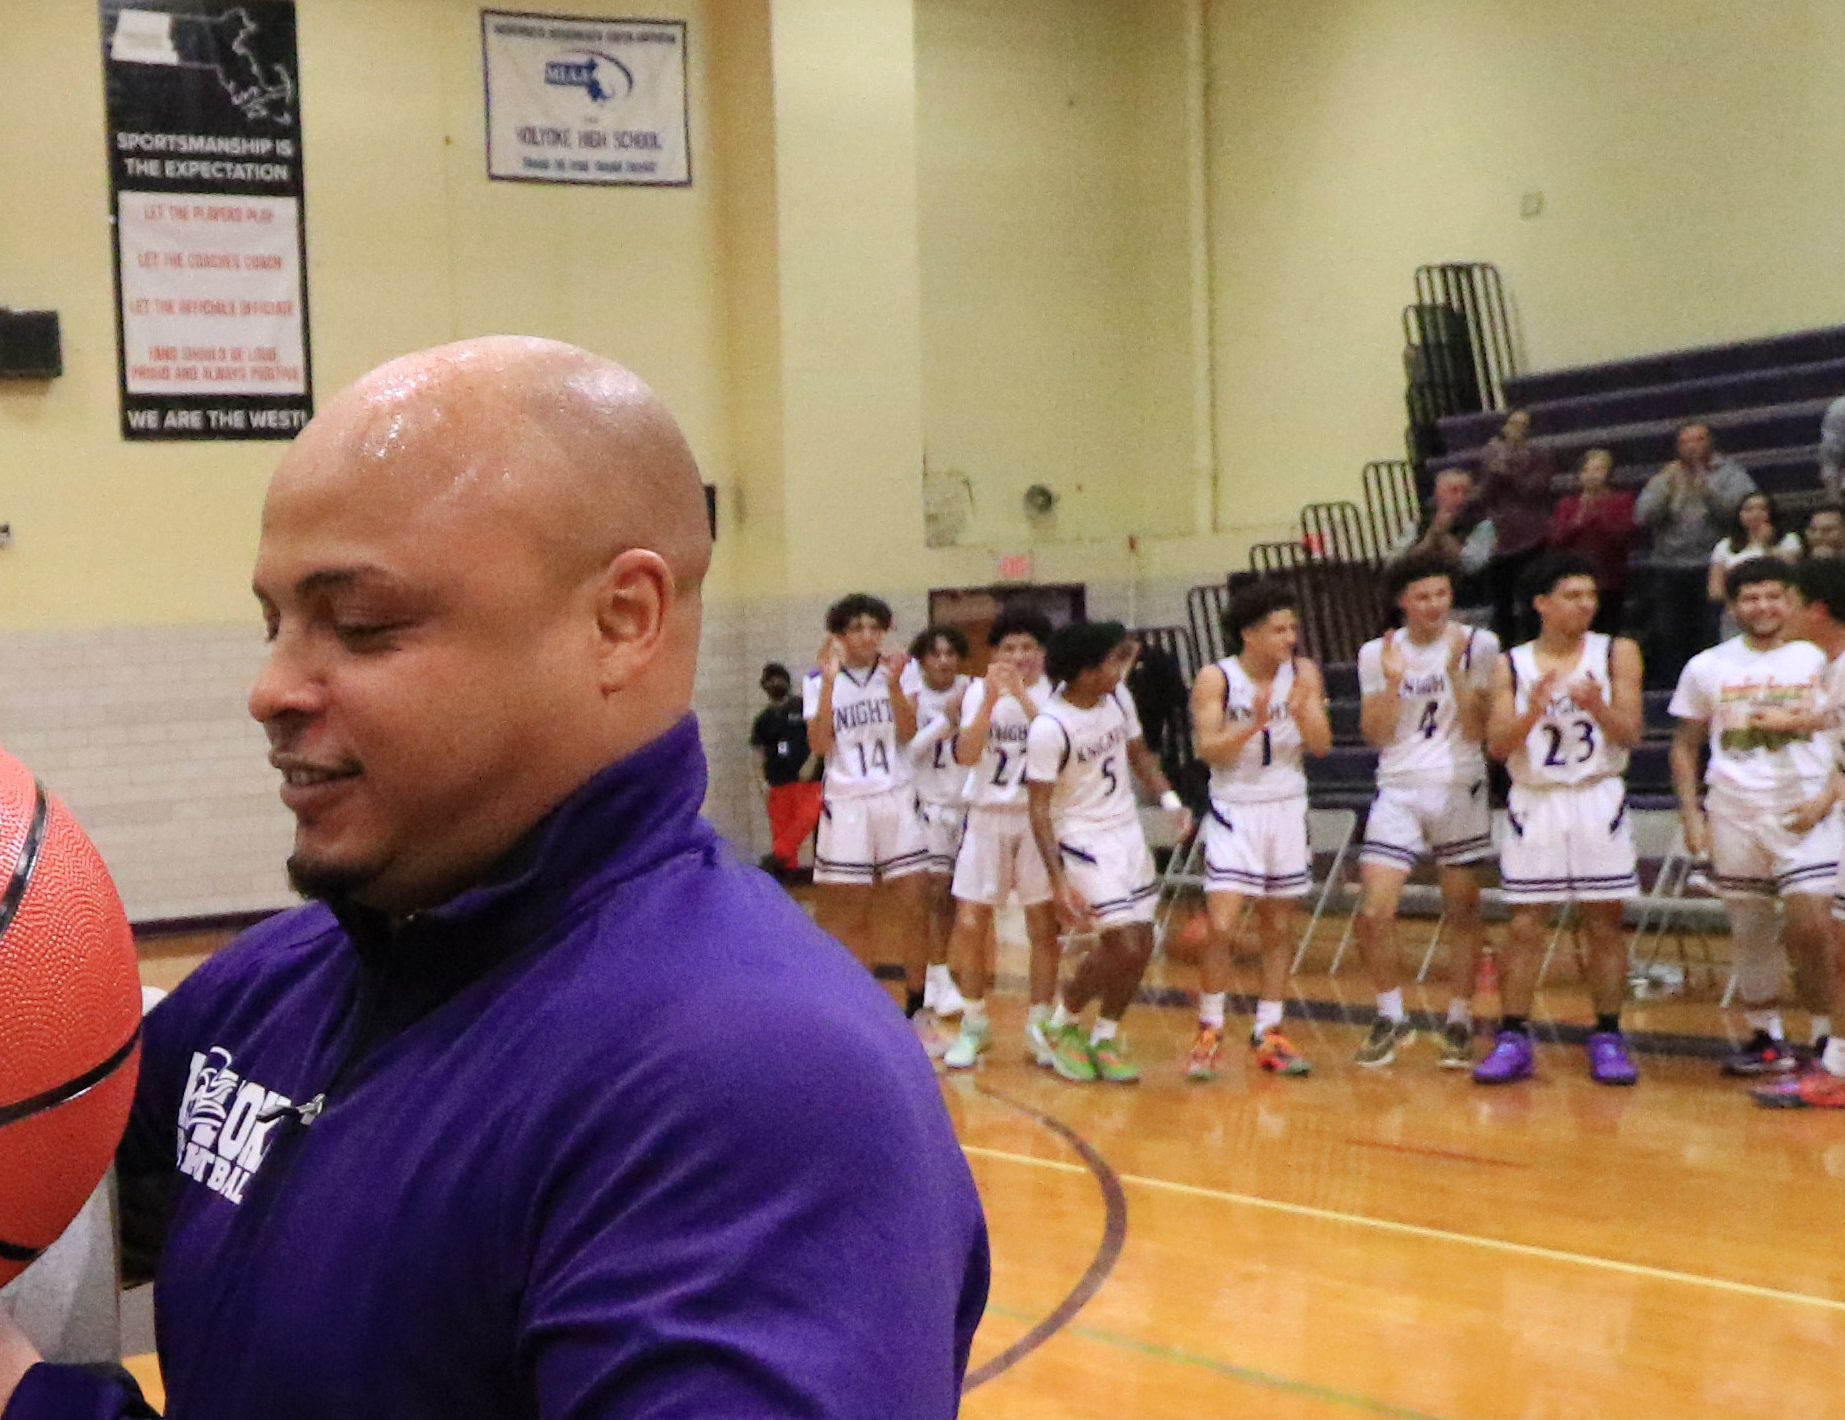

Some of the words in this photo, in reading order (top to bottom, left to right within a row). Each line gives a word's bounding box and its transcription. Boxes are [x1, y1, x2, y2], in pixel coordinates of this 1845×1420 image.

[117, 132, 270, 155] SPORTSMANSHIP
[275, 138, 293, 157] IS
[125, 157, 161, 178] THE
[165, 159, 288, 181] EXPECTATION
[127, 409, 158, 429] WE
[163, 410, 202, 429] ARE
[206, 410, 245, 429] THE
[1418, 701, 1439, 739] 4
[856, 739, 889, 777] 14
[1542, 720, 1595, 767] 23
[1101, 755, 1117, 796] 5
